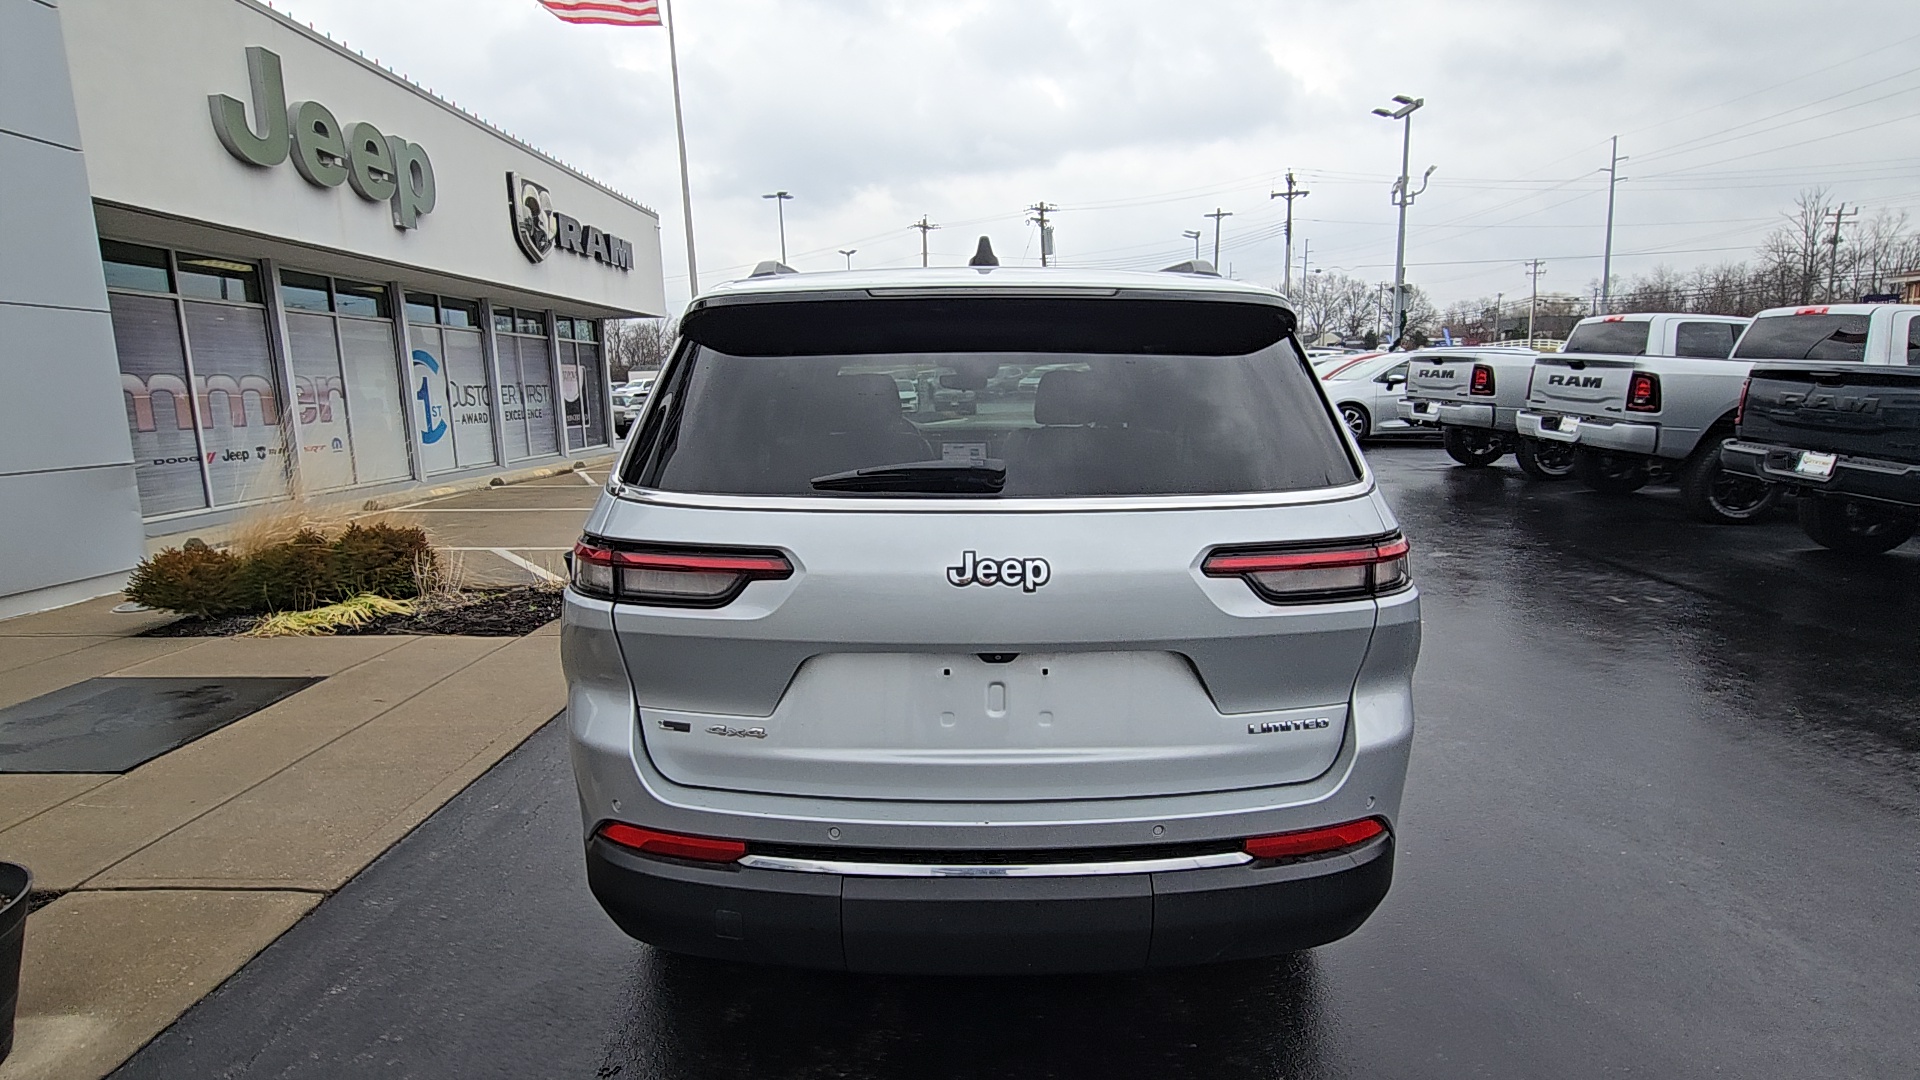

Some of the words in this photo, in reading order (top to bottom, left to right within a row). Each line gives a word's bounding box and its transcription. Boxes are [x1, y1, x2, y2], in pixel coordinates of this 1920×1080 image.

[207, 46, 436, 231] Jeep
[553, 211, 635, 271] RAM
[1418, 369, 1455, 379] RAM
[1548, 374, 1603, 389] RAM
[1777, 391, 1881, 415] RAM
[461, 412, 489, 425] AWARD
[505, 409, 543, 422] EXCELENCE
[153, 456, 201, 466] DODG
[222, 448, 250, 463] Jeep
[946, 550, 1051, 592] Jeep
[1248, 717, 1330, 734] LIMITED
